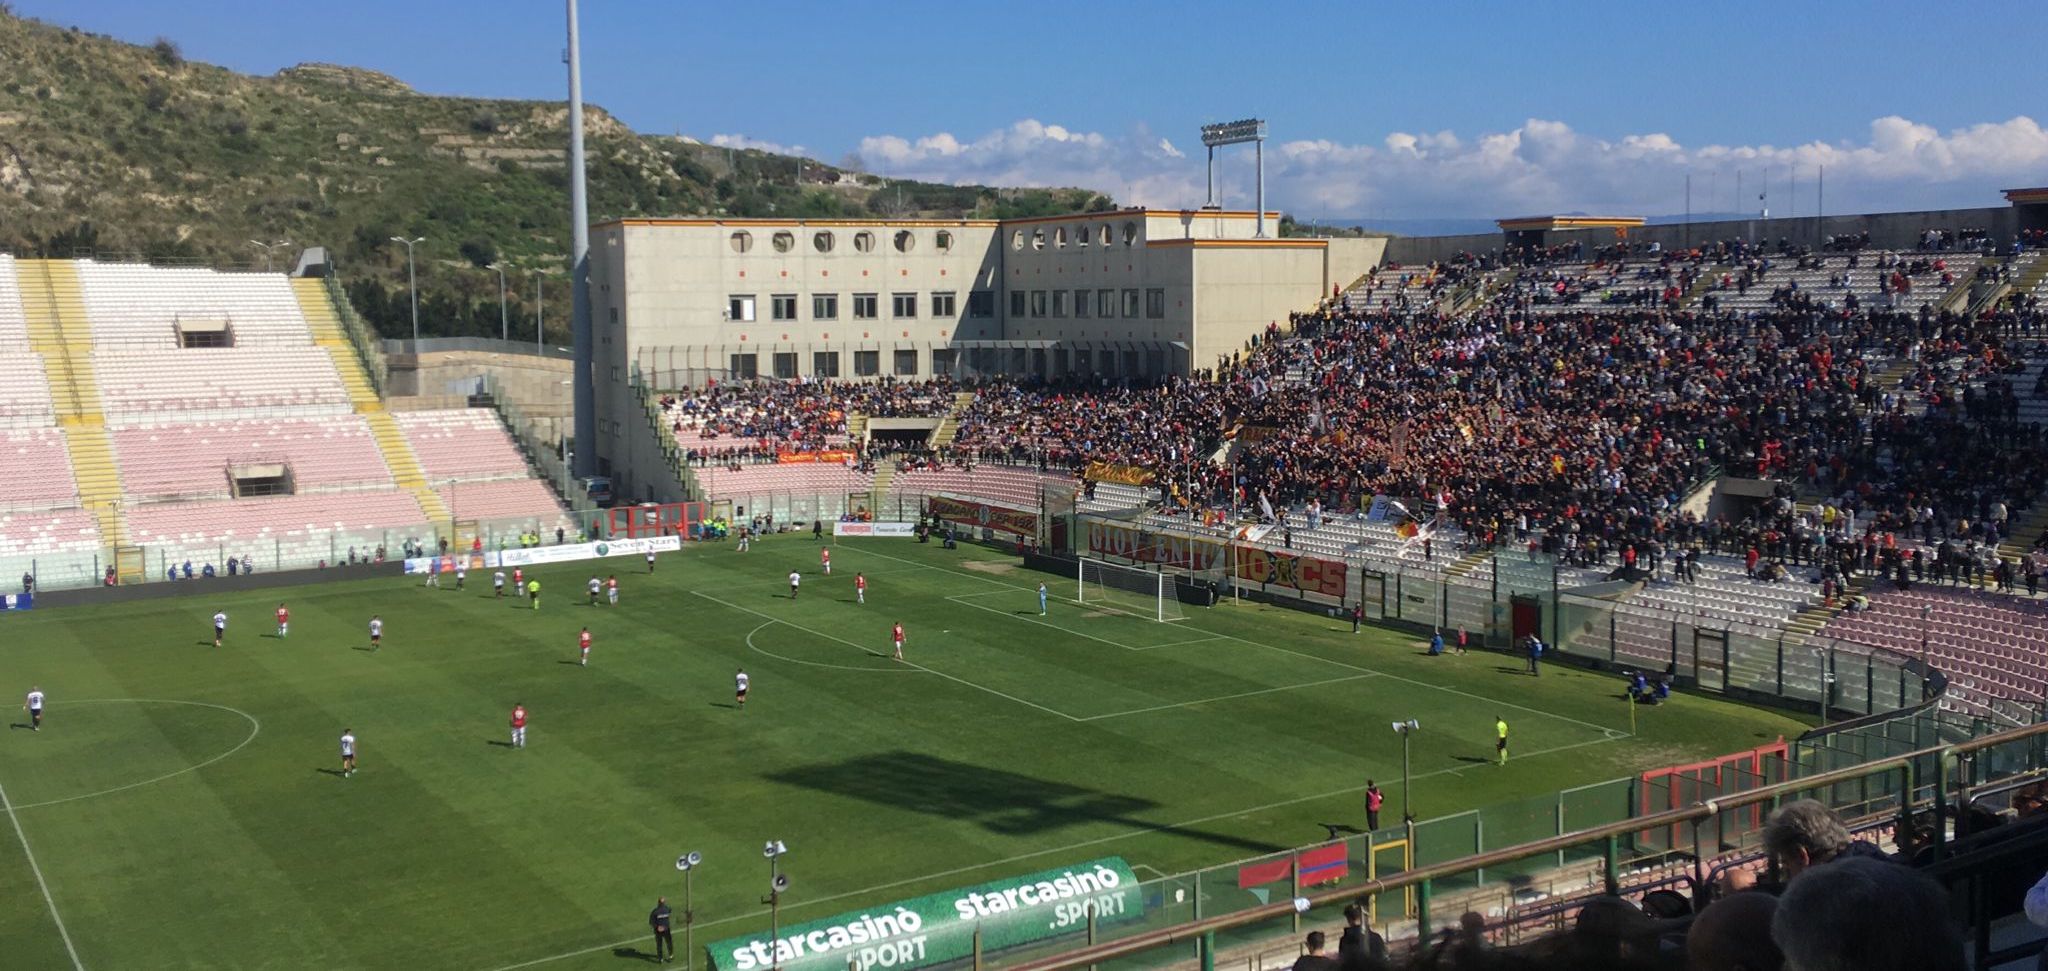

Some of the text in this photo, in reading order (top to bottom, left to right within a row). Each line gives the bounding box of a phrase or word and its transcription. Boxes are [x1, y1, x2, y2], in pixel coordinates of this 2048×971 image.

[954, 864, 1120, 920] starcasinò
[1049, 891, 1126, 929] .SPORT
[733, 907, 922, 969] starcasinò
